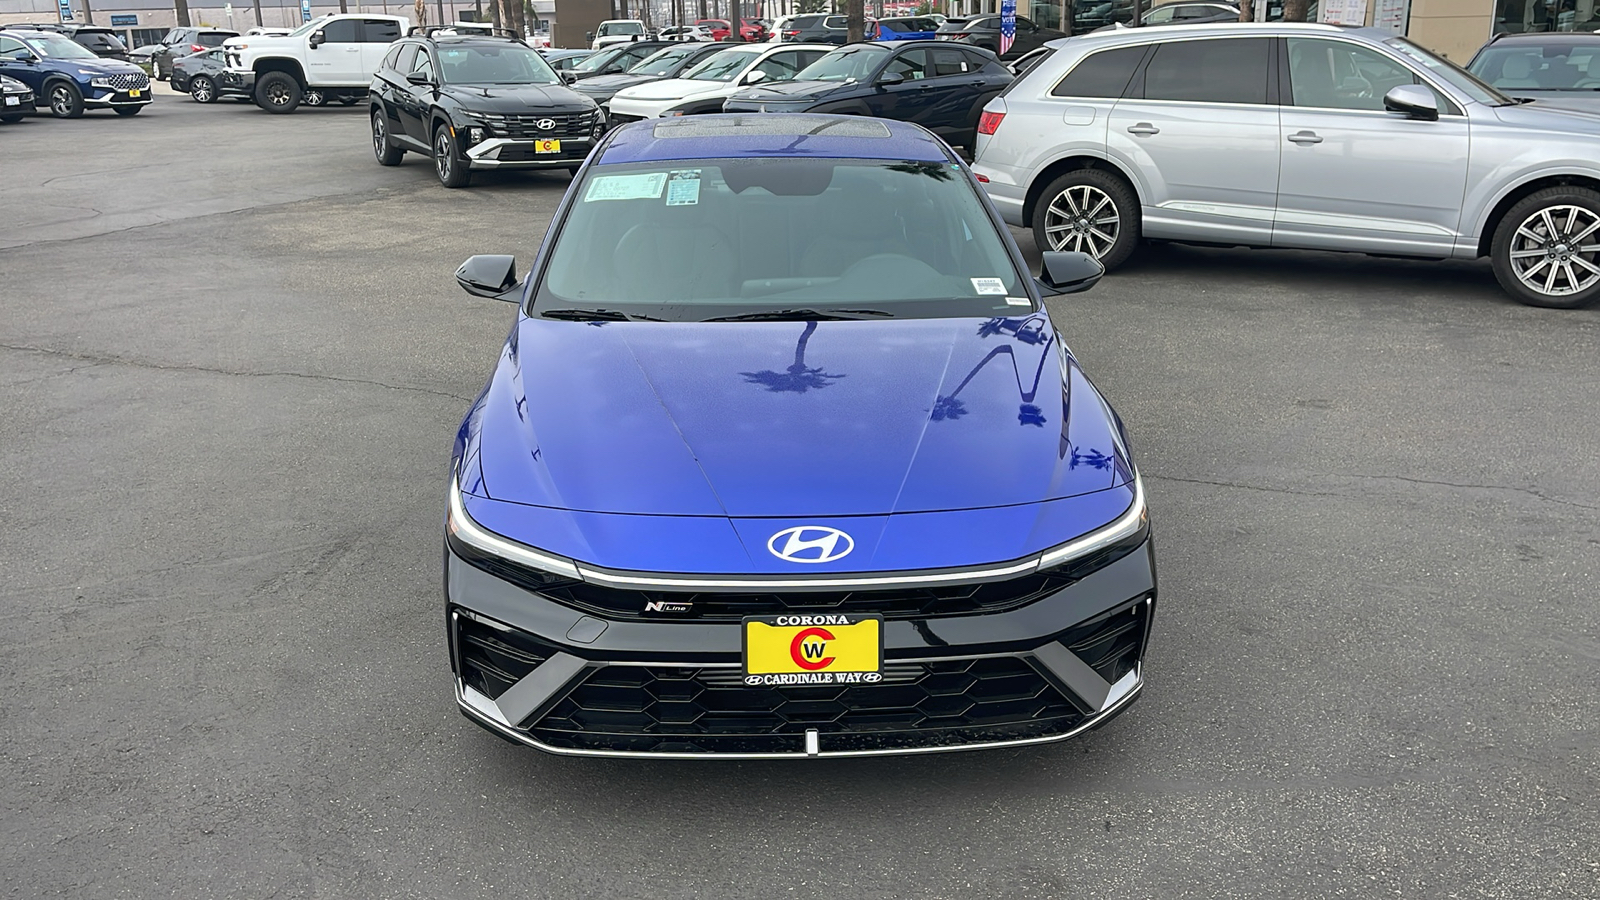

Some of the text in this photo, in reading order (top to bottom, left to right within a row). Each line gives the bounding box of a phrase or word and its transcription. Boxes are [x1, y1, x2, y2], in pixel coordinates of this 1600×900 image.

[776, 615, 849, 626] CORONA
[790, 627, 836, 670] C
[803, 641, 827, 659] W
[763, 672, 863, 685] CARDINALE WAY
